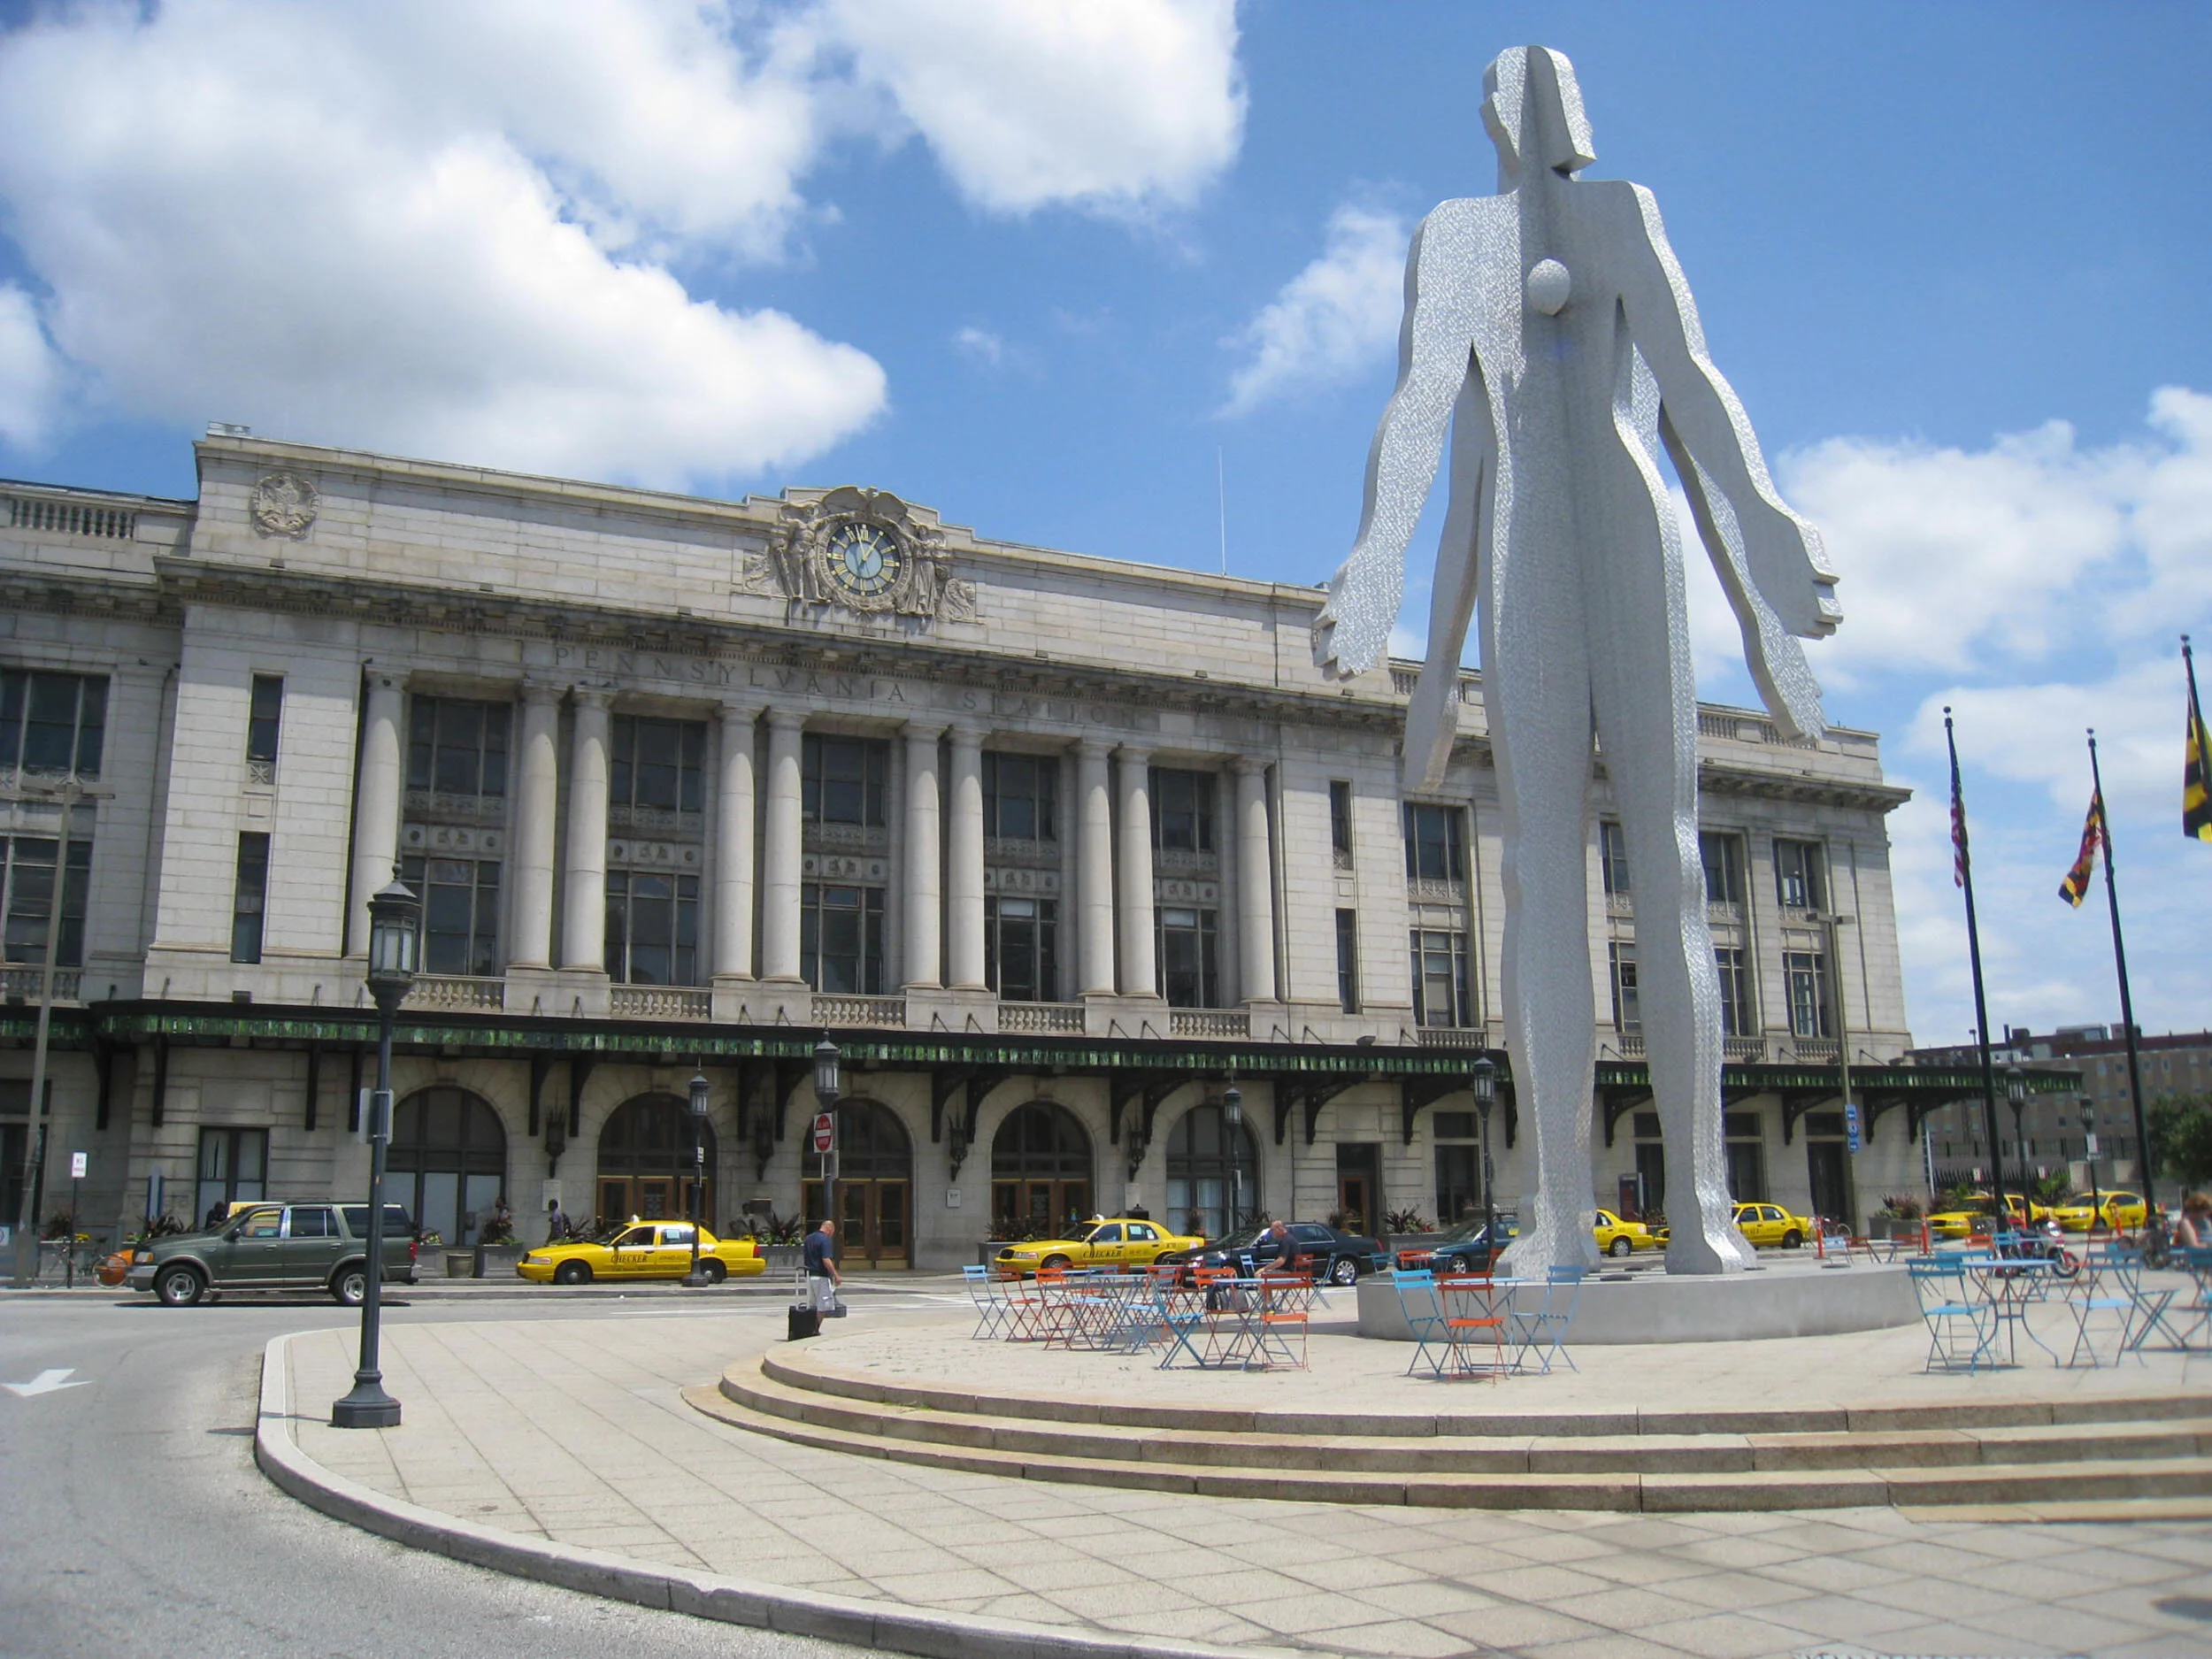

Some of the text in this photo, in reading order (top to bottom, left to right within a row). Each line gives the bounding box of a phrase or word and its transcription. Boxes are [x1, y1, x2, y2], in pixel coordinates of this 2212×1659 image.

[554, 647, 1137, 726] PENNSYLVANIA STATION
[611, 1254, 648, 1263] CHECKER
